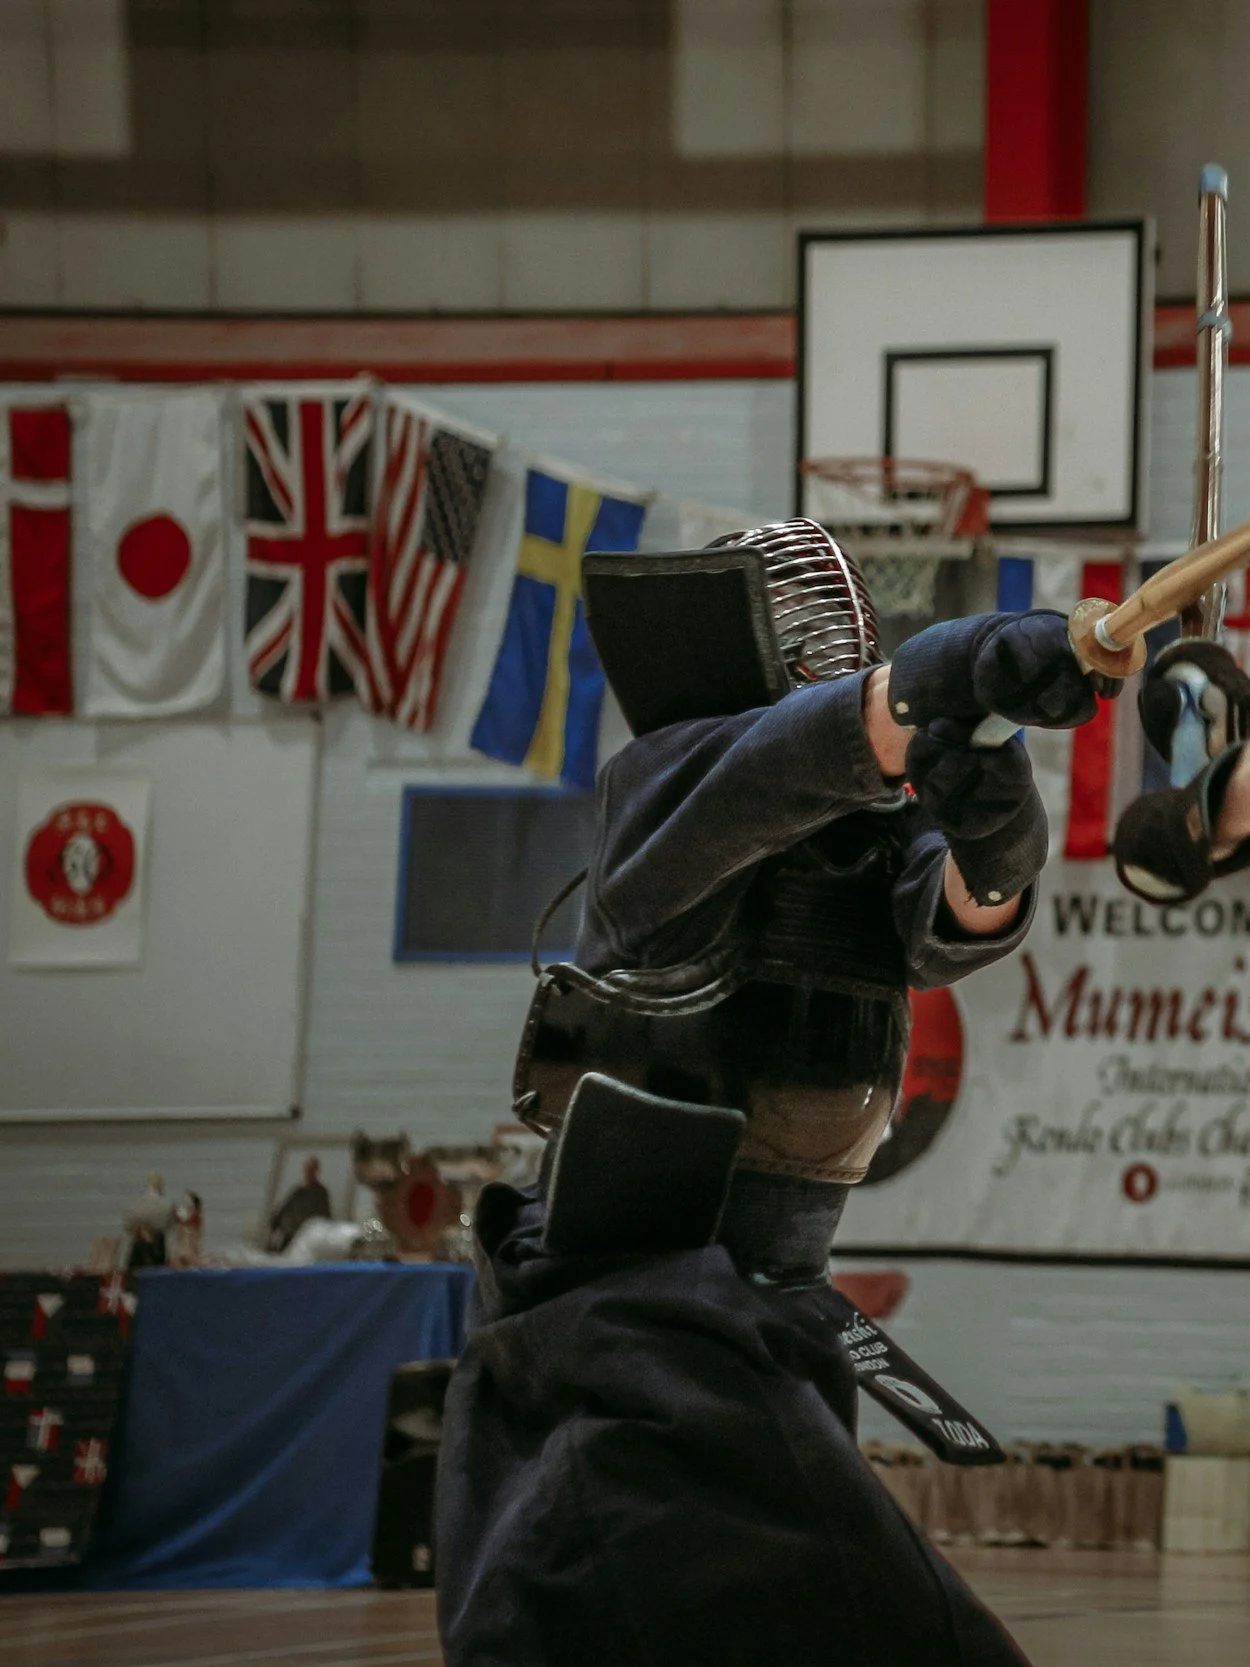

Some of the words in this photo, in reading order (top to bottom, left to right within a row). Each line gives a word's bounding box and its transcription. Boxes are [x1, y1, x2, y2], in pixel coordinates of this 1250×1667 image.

[838, 1311, 878, 1345] eishi
[858, 1341, 889, 1357] CLUB
[931, 1418, 990, 1449] TODA
